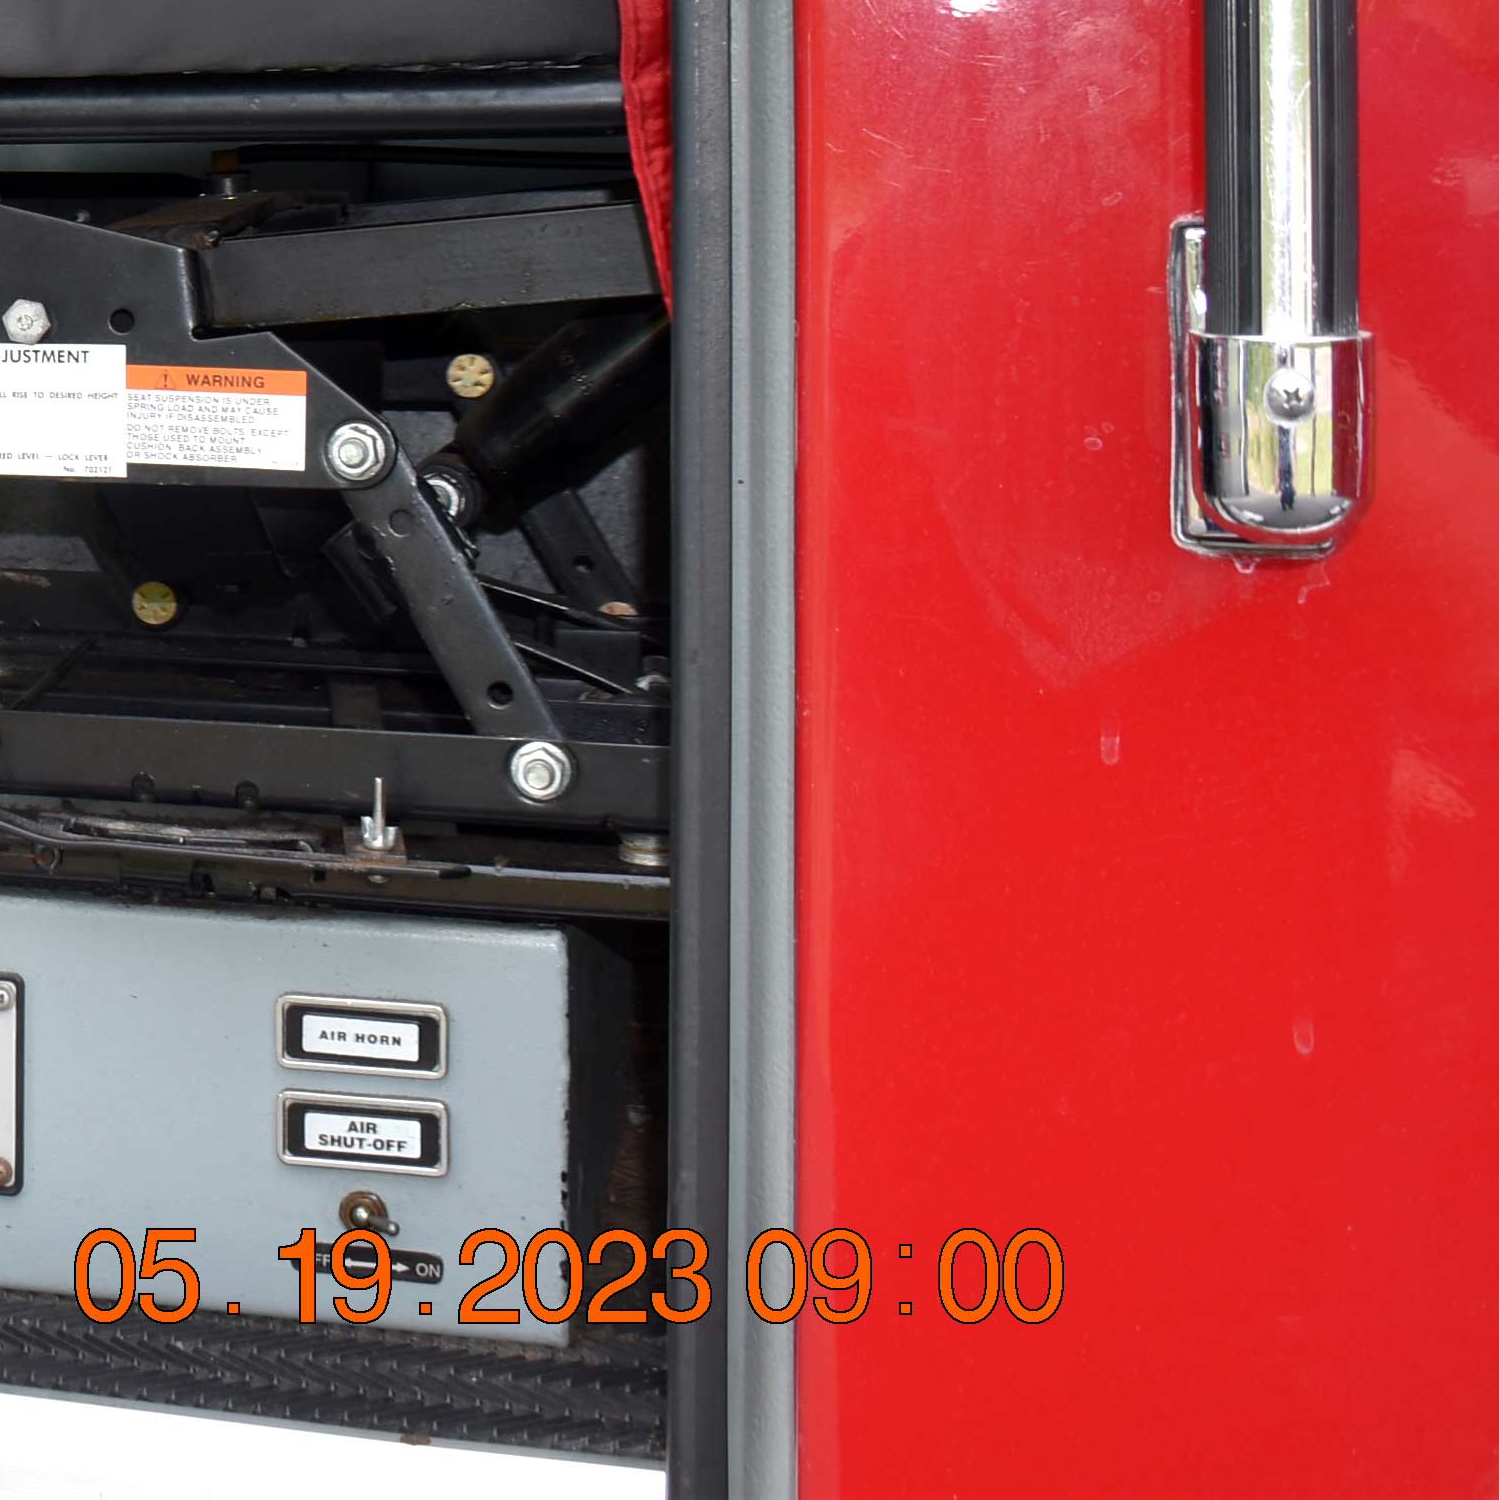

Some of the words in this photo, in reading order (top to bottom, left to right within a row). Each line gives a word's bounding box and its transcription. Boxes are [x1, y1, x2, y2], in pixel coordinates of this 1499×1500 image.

[186, 373, 265, 389] WARNING
[49, 392, 82, 400] DESIRED
[128, 393, 151, 401] SEAT
[155, 395, 219, 404] SUSPENSION
[235, 398, 270, 406] UNDER
[127, 403, 164, 411] SPRING
[245, 407, 279, 416] CAUSE
[127, 412, 162, 420] INJURY
[127, 424, 141, 432] DO
[169, 426, 209, 434] REMOVE
[127, 433, 160, 441] THOSE
[210, 437, 245, 445] MOUNT
[145, 452, 178, 460] SHOCK
[318, 1029, 347, 1042] AIR
[355, 1032, 402, 1047] HORN
[347, 1120, 378, 1135] AIR
[318, 1133, 408, 1153] SHUT-OFF
[415, 1258, 441, 1278] ON
